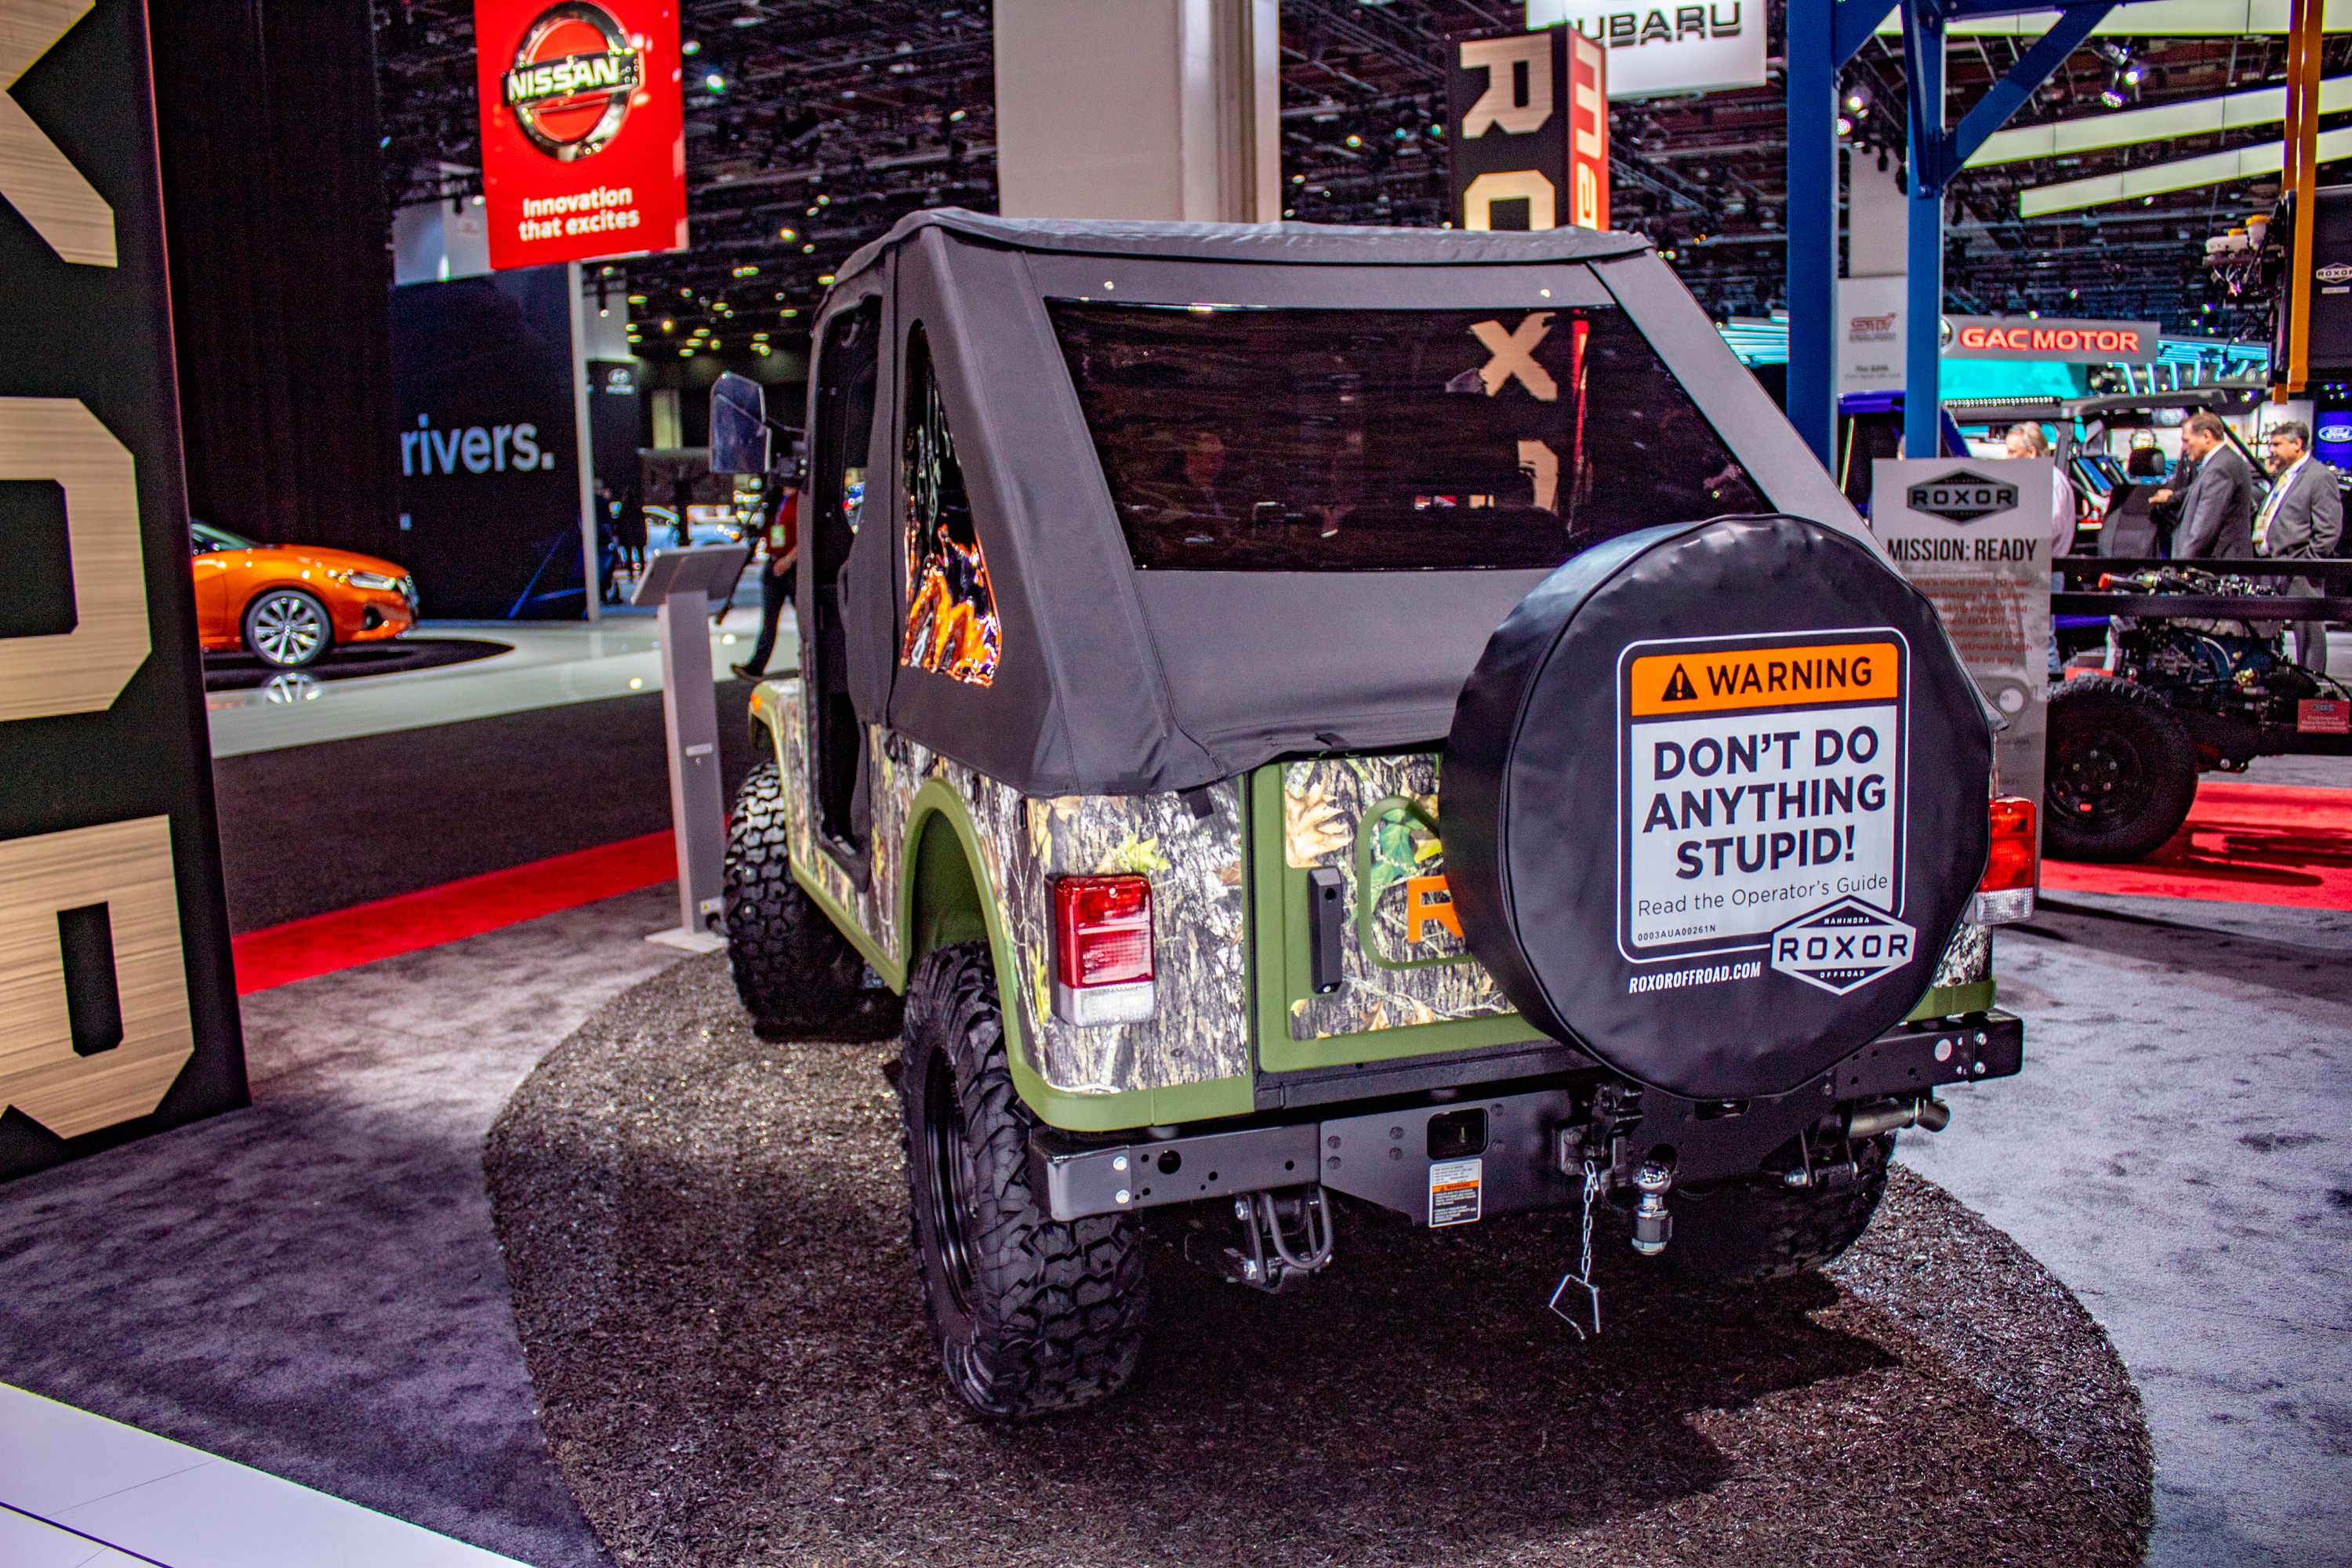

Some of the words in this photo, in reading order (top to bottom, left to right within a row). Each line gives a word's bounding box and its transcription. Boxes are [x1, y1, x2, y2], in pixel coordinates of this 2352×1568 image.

[1576, 1, 1742, 48] UBARU
[508, 57, 620, 100] NISSAN
[523, 186, 633, 218] Innovation
[518, 217, 562, 241] that
[565, 209, 640, 235] excites
[1962, 328, 2029, 350] GAC
[2032, 329, 2139, 352] MOTOR
[1912, 489, 2013, 506] ROXOR
[1888, 539, 1970, 561] MISSION:
[1975, 538, 2038, 561] READY
[1707, 657, 1872, 696] WARNING
[1654, 731, 1800, 781] DON'T
[1815, 726, 1878, 767] DO
[1642, 774, 1886, 833] ANYTHING
[1675, 825, 1855, 880] STUPID!
[1639, 895, 1686, 916] Read
[1694, 892, 1724, 910] the
[1731, 879, 1830, 907] Operator's
[1837, 873, 1888, 893] Guide
[1638, 924, 1716, 942] 0003AUA00261N
[1824, 916, 1870, 925] MAHINDRA
[1779, 934, 1907, 962] ROXOR
[1628, 961, 1762, 993] ROXOROFFROAD.COM
[1820, 970, 1865, 978] OFFROAD
